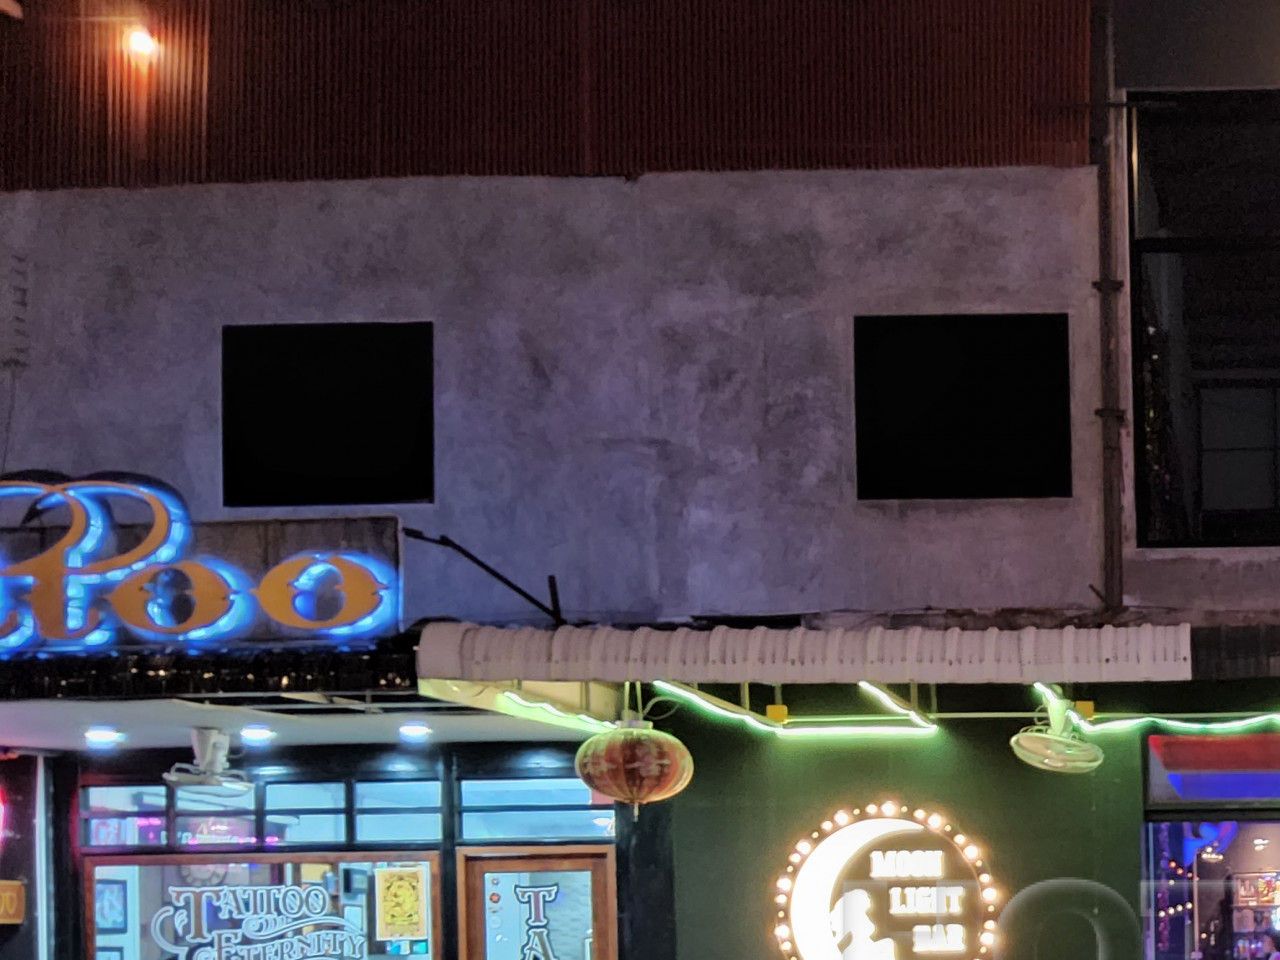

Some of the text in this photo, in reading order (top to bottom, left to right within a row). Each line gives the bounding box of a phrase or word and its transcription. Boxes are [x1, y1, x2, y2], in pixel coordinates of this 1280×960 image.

[869, 849, 944, 879] MOON
[888, 886, 966, 915] LIGHT
[912, 922, 967, 951] BAR
